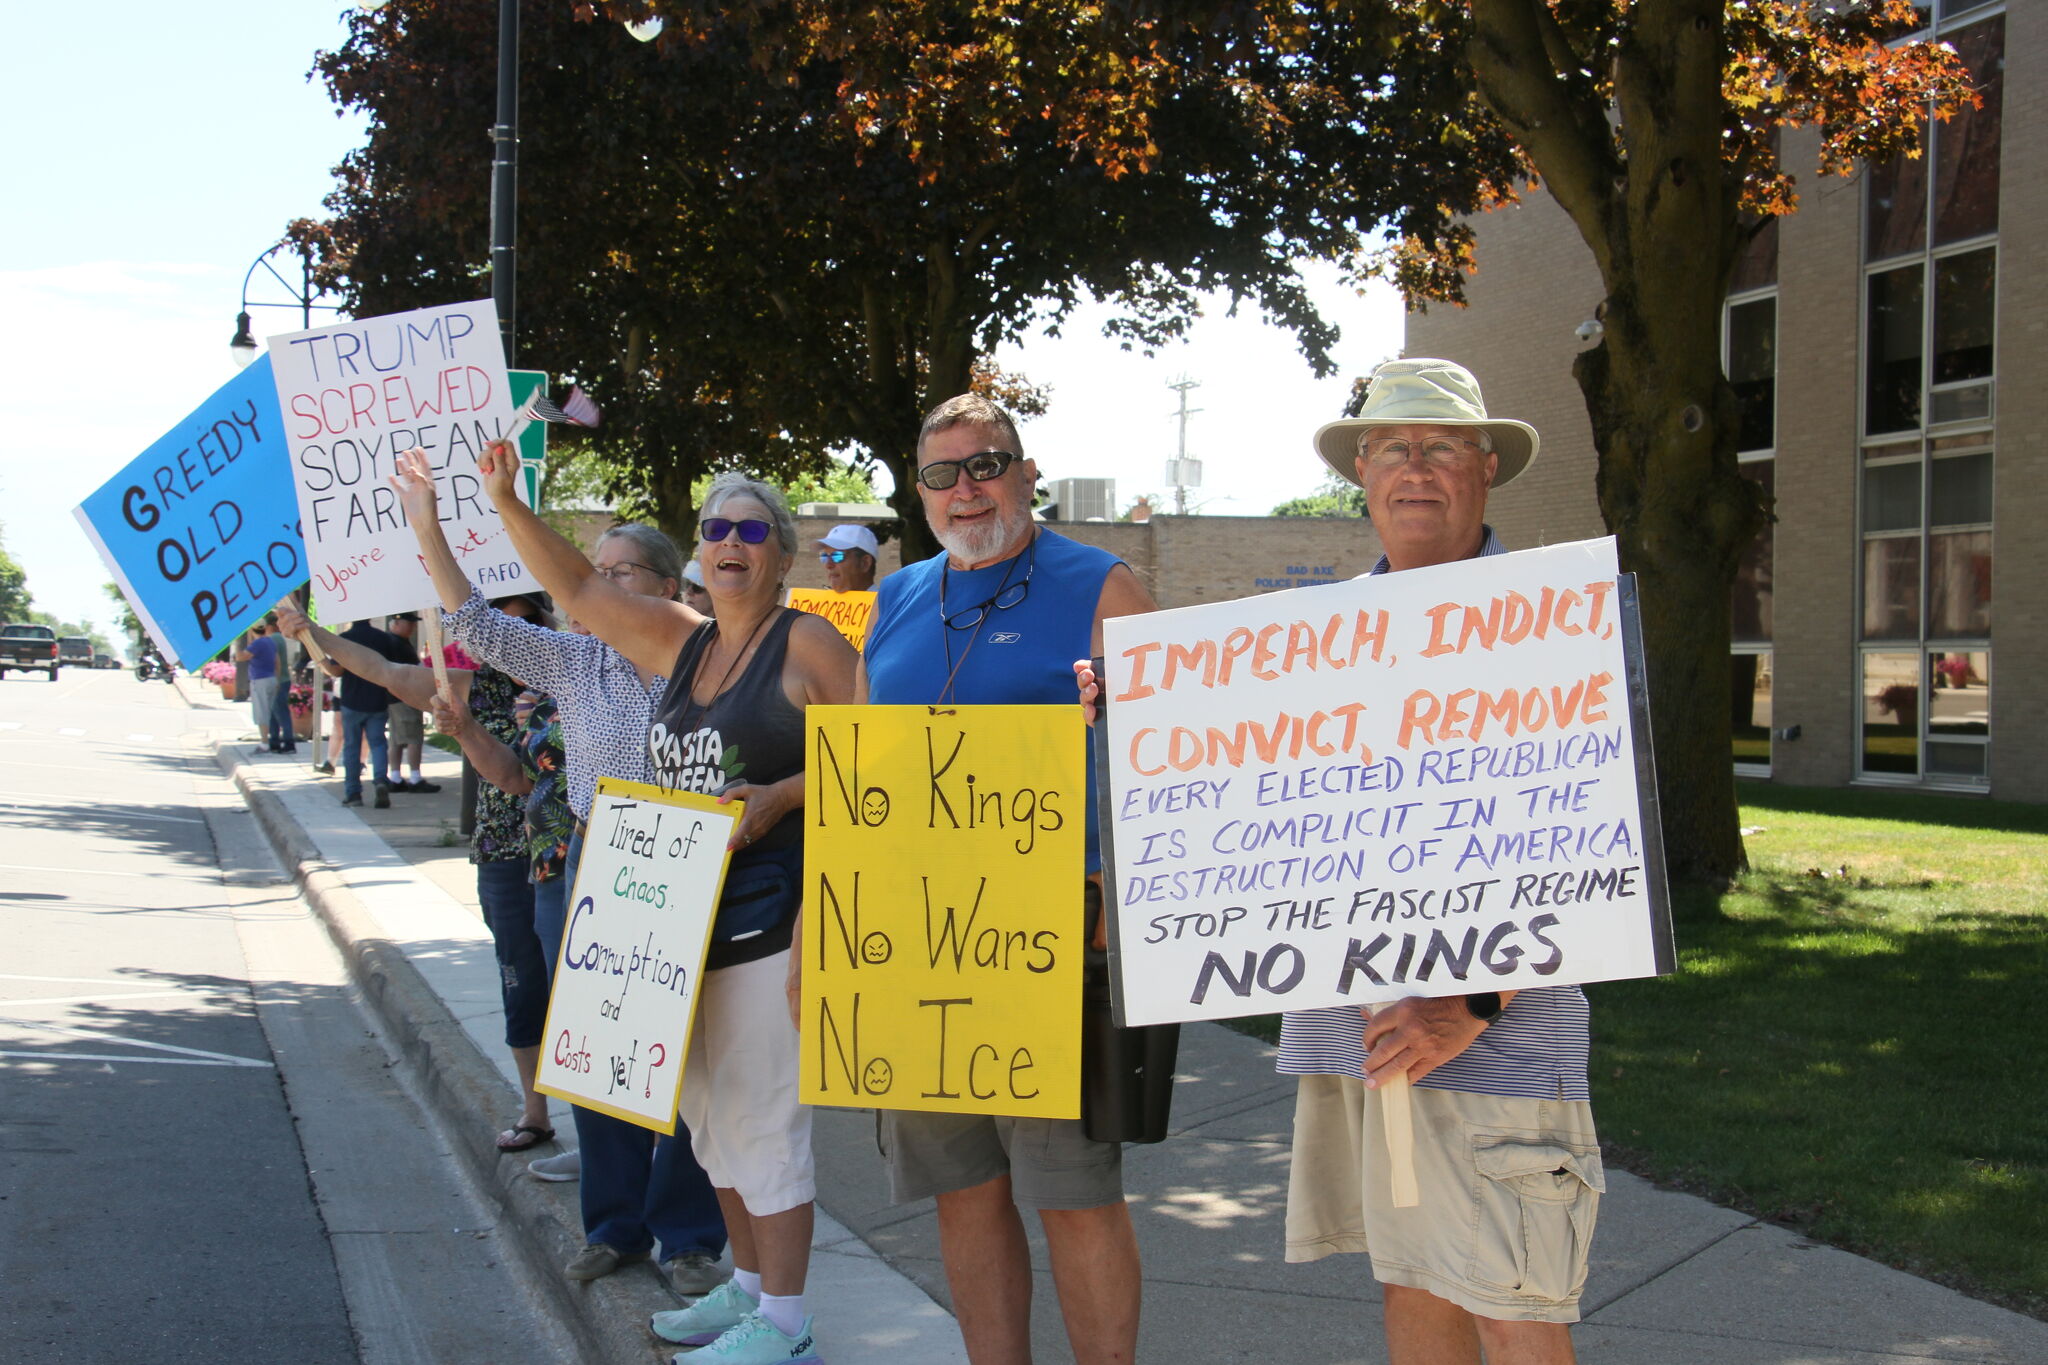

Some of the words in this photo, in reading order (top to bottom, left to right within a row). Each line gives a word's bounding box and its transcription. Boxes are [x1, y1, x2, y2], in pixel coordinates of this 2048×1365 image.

[290, 314, 474, 382] TRUMP
[291, 366, 492, 439] SCREWED
[121, 399, 262, 532] GREEDY
[301, 417, 502, 491] SOYBEAN
[156, 499, 243, 582] OLD
[478, 562, 521, 585] FAFO
[1286, 566, 1308, 575] BAD
[1313, 566, 1335, 575] AXE
[1255, 578, 1292, 587] POLICE
[1115, 608, 1397, 702] IMPEACH,
[1418, 580, 1615, 658] INDICT,
[650, 722, 723, 768] PASTA
[1129, 702, 1374, 776] CONVICT,
[1398, 671, 1614, 750] REMOVE
[817, 723, 890, 828] No
[925, 725, 1063, 855] Kings
[1119, 778, 1231, 822] EVERY
[1256, 756, 1403, 807] ELECTED
[1417, 726, 1623, 787] REPUBLICAN
[608, 802, 662, 860] Tired
[668, 820, 702, 860] of
[1133, 829, 1187, 866] IS
[1212, 802, 1423, 855] COMPLICIT
[1433, 796, 1496, 832] IN
[1517, 779, 1600, 819] THE
[1124, 849, 1364, 907] DESTRUCTION
[1388, 838, 1444, 875] OF
[1454, 818, 1639, 873] AMERICA.
[820, 871, 892, 971] No
[921, 876, 1060, 974] Wars
[1144, 906, 1248, 945] STOP
[1263, 898, 1335, 932] THE
[1347, 879, 1501, 926] FASCIST
[1509, 866, 1640, 911] REGIME
[1190, 942, 1306, 1005] NO
[1336, 913, 1564, 995] KINGS
[600, 992, 624, 1022] and
[820, 992, 893, 1096] No
[918, 997, 1040, 1101] Ice
[554, 1028, 592, 1075] Costs
[609, 1039, 638, 1096] yet
[790, 1335, 813, 1358] HOKA
